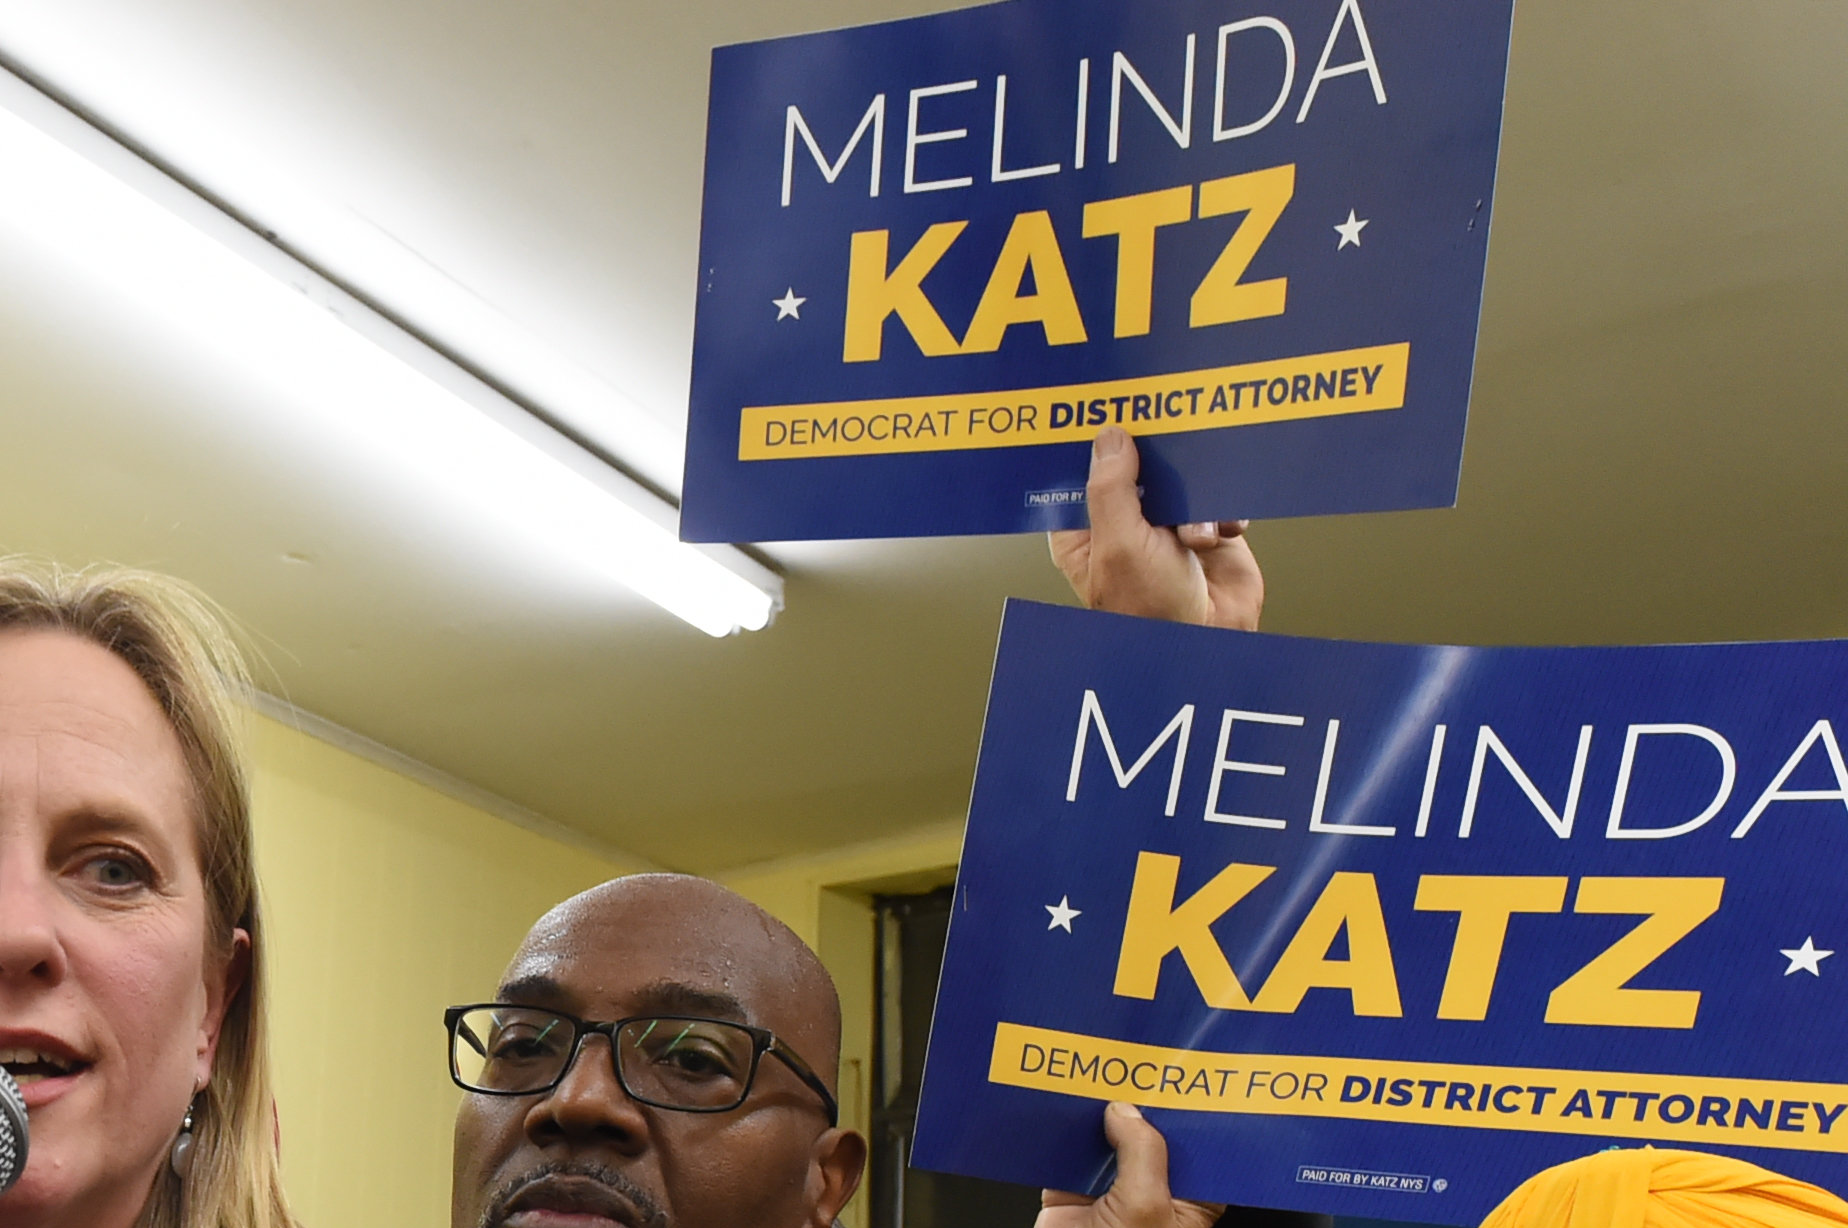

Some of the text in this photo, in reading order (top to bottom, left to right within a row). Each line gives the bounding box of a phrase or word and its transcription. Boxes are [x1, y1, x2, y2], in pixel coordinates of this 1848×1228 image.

[781, 0, 1387, 207] MELINDA
[842, 163, 1296, 363] KATZ
[765, 364, 1384, 446] DEMOCRAT FOR DISTRICT ATTORNEY
[1029, 491, 1084, 505] PAID FOR BY
[1066, 689, 1848, 839] MELINDA
[1113, 851, 1726, 1029] KATZ
[1019, 1043, 1848, 1134] DEMOCRAT FOR DISTRICT ATTORNEY
[1302, 1169, 1327, 1182] PAID
[1328, 1171, 1351, 1184] FOR
[1353, 1174, 1369, 1186] BY
[1370, 1175, 1399, 1189] KATZ
[1400, 1178, 1424, 1190] NYS
